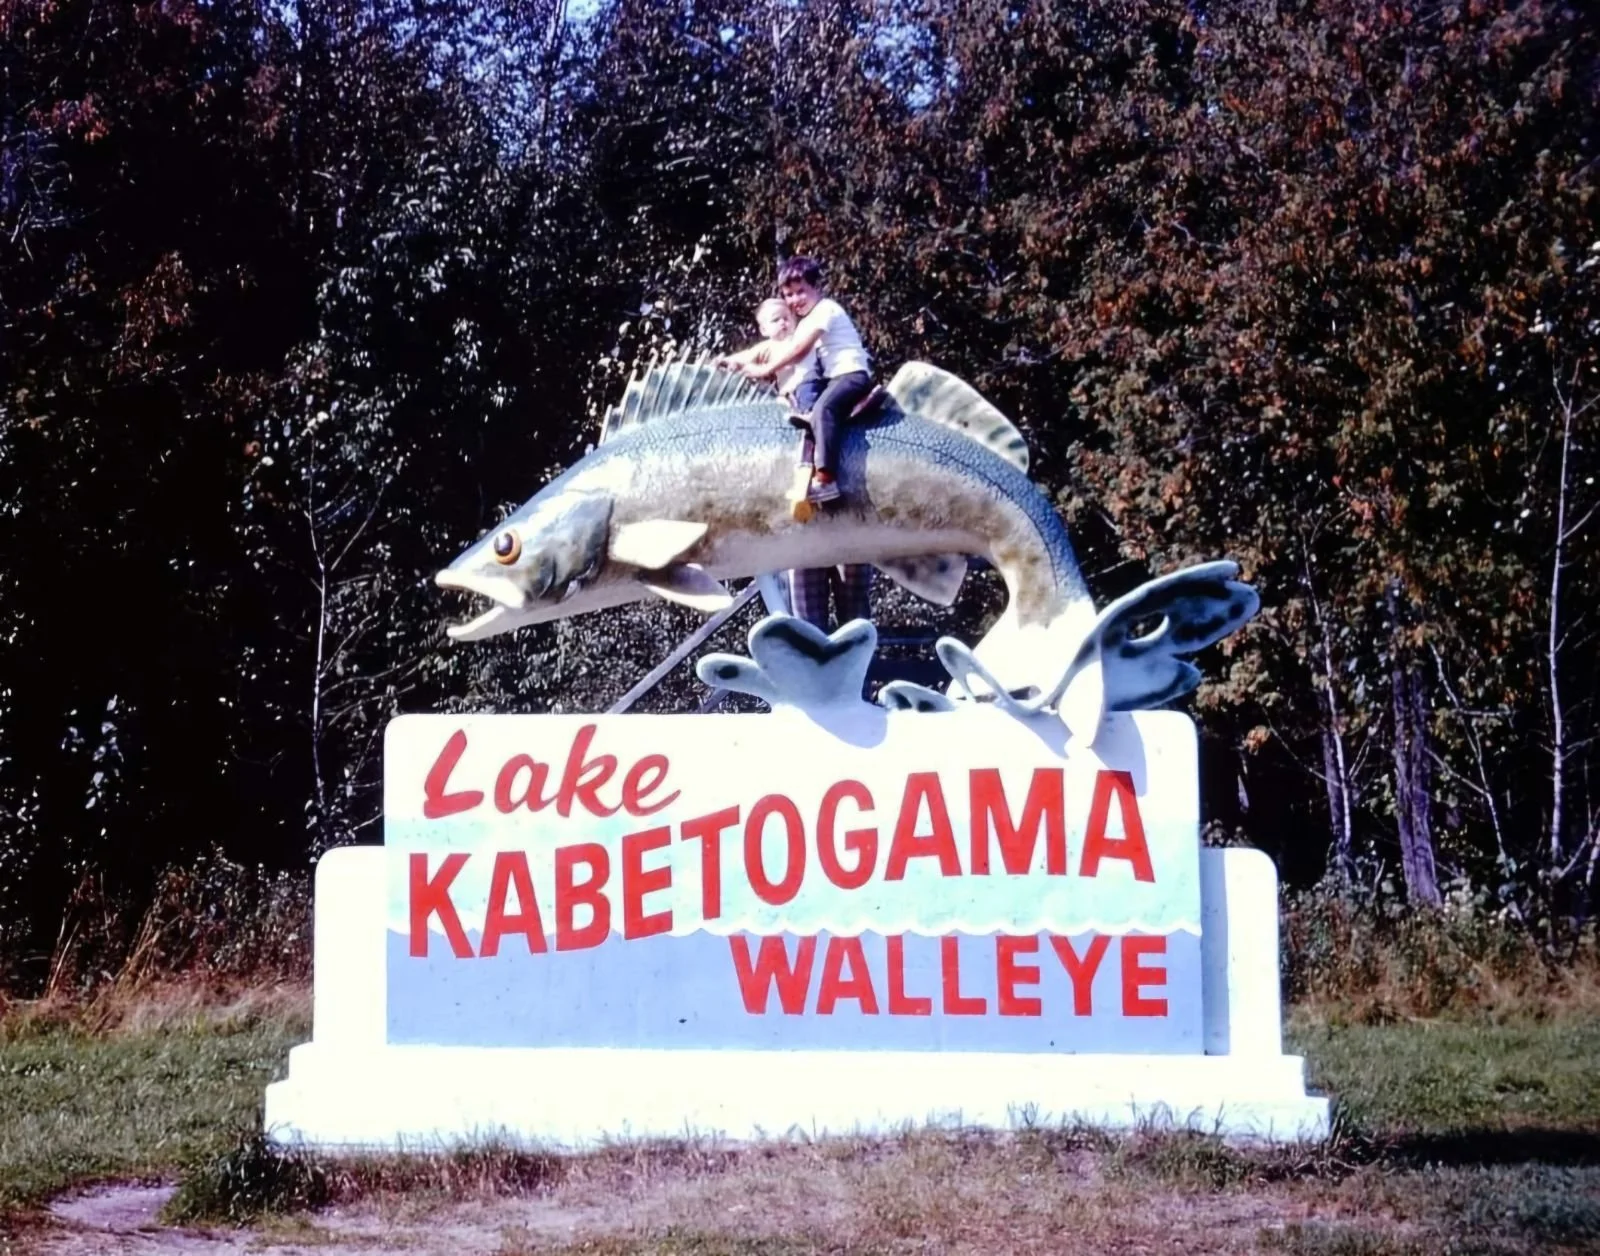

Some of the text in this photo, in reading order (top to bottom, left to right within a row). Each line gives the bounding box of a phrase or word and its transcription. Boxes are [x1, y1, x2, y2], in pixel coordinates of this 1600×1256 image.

[423, 725, 680, 819] Lake
[409, 767, 1156, 959] KABETOGAMA
[729, 934, 1169, 1017] WALLEYE
